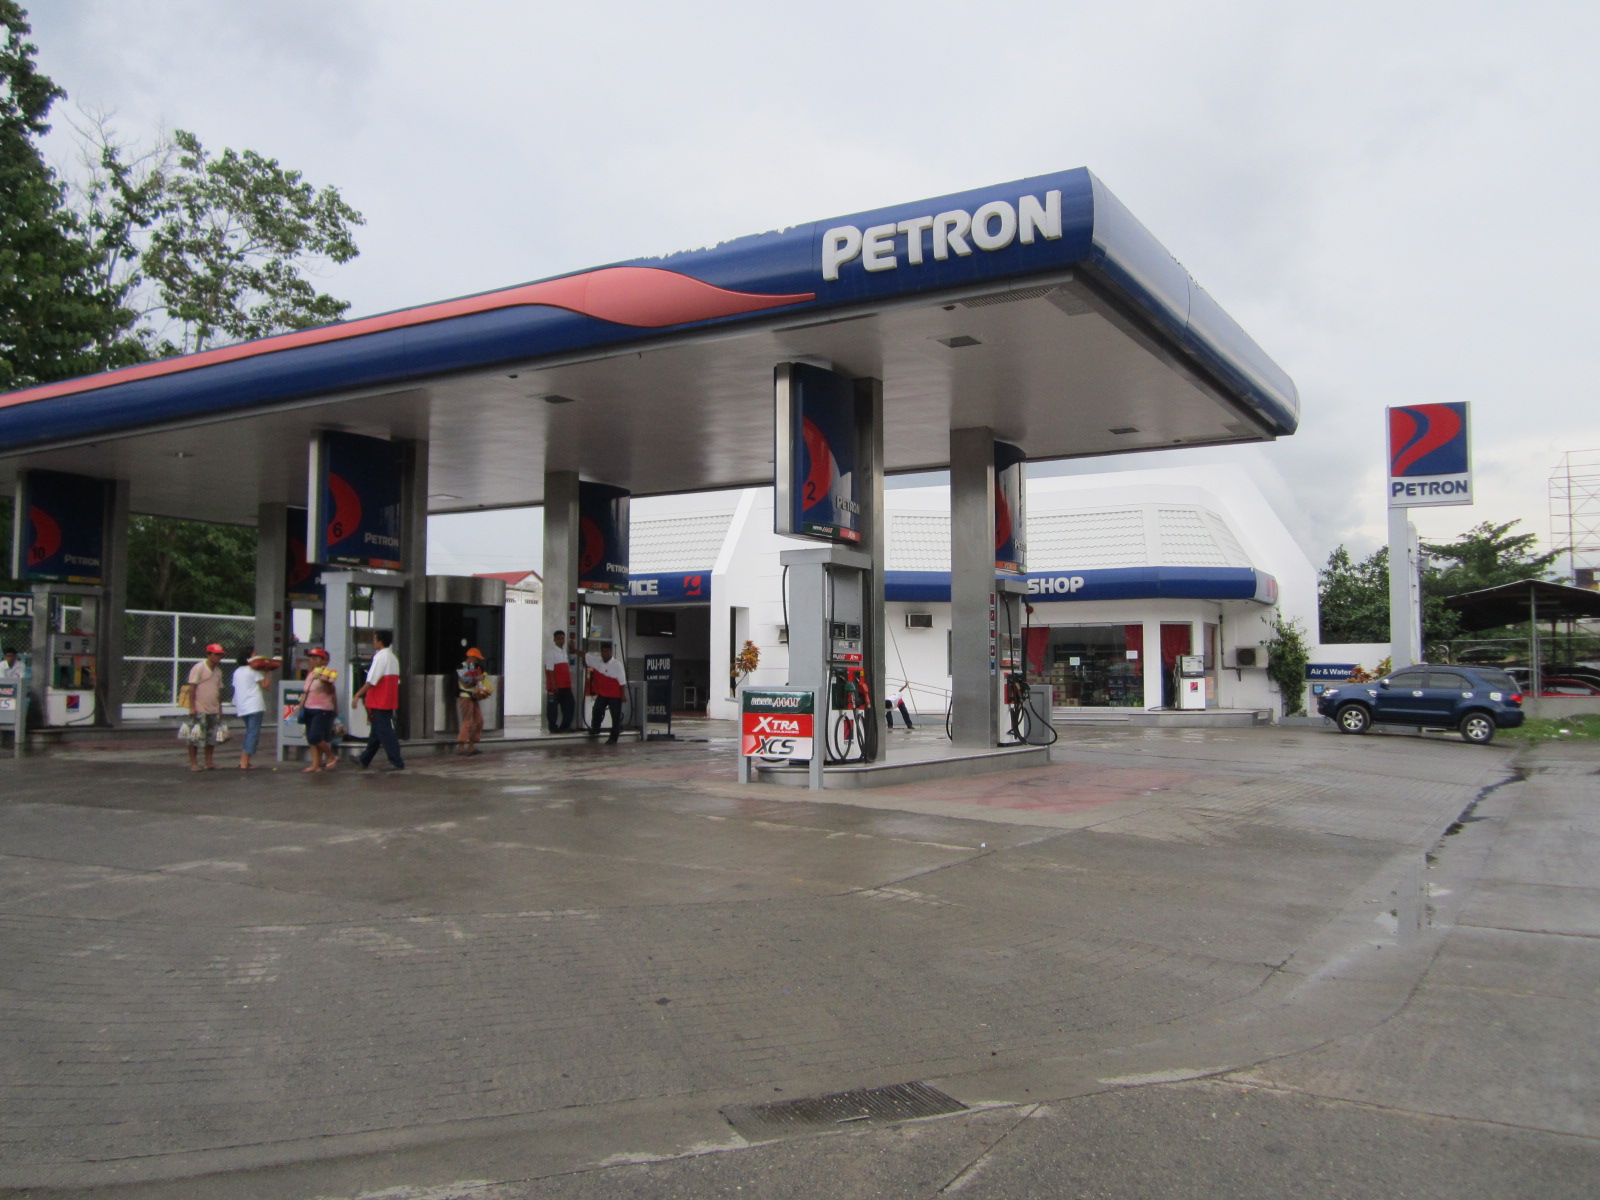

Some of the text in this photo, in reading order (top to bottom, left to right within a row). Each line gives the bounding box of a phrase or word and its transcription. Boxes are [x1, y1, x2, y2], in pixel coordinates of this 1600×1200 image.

[822, 189, 1062, 281] PETRON
[806, 481, 816, 501] 2
[1392, 480, 1468, 497] PETRON
[333, 522, 343, 538] 6
[364, 532, 399, 547] PETRON
[33, 546, 46, 560] 10
[64, 554, 100, 567] PETRON
[1027, 576, 1085, 594] SHOP
[1329, 668, 1352, 676] Water
[752, 716, 799, 733] XTRA
[753, 737, 797, 755] XCS
